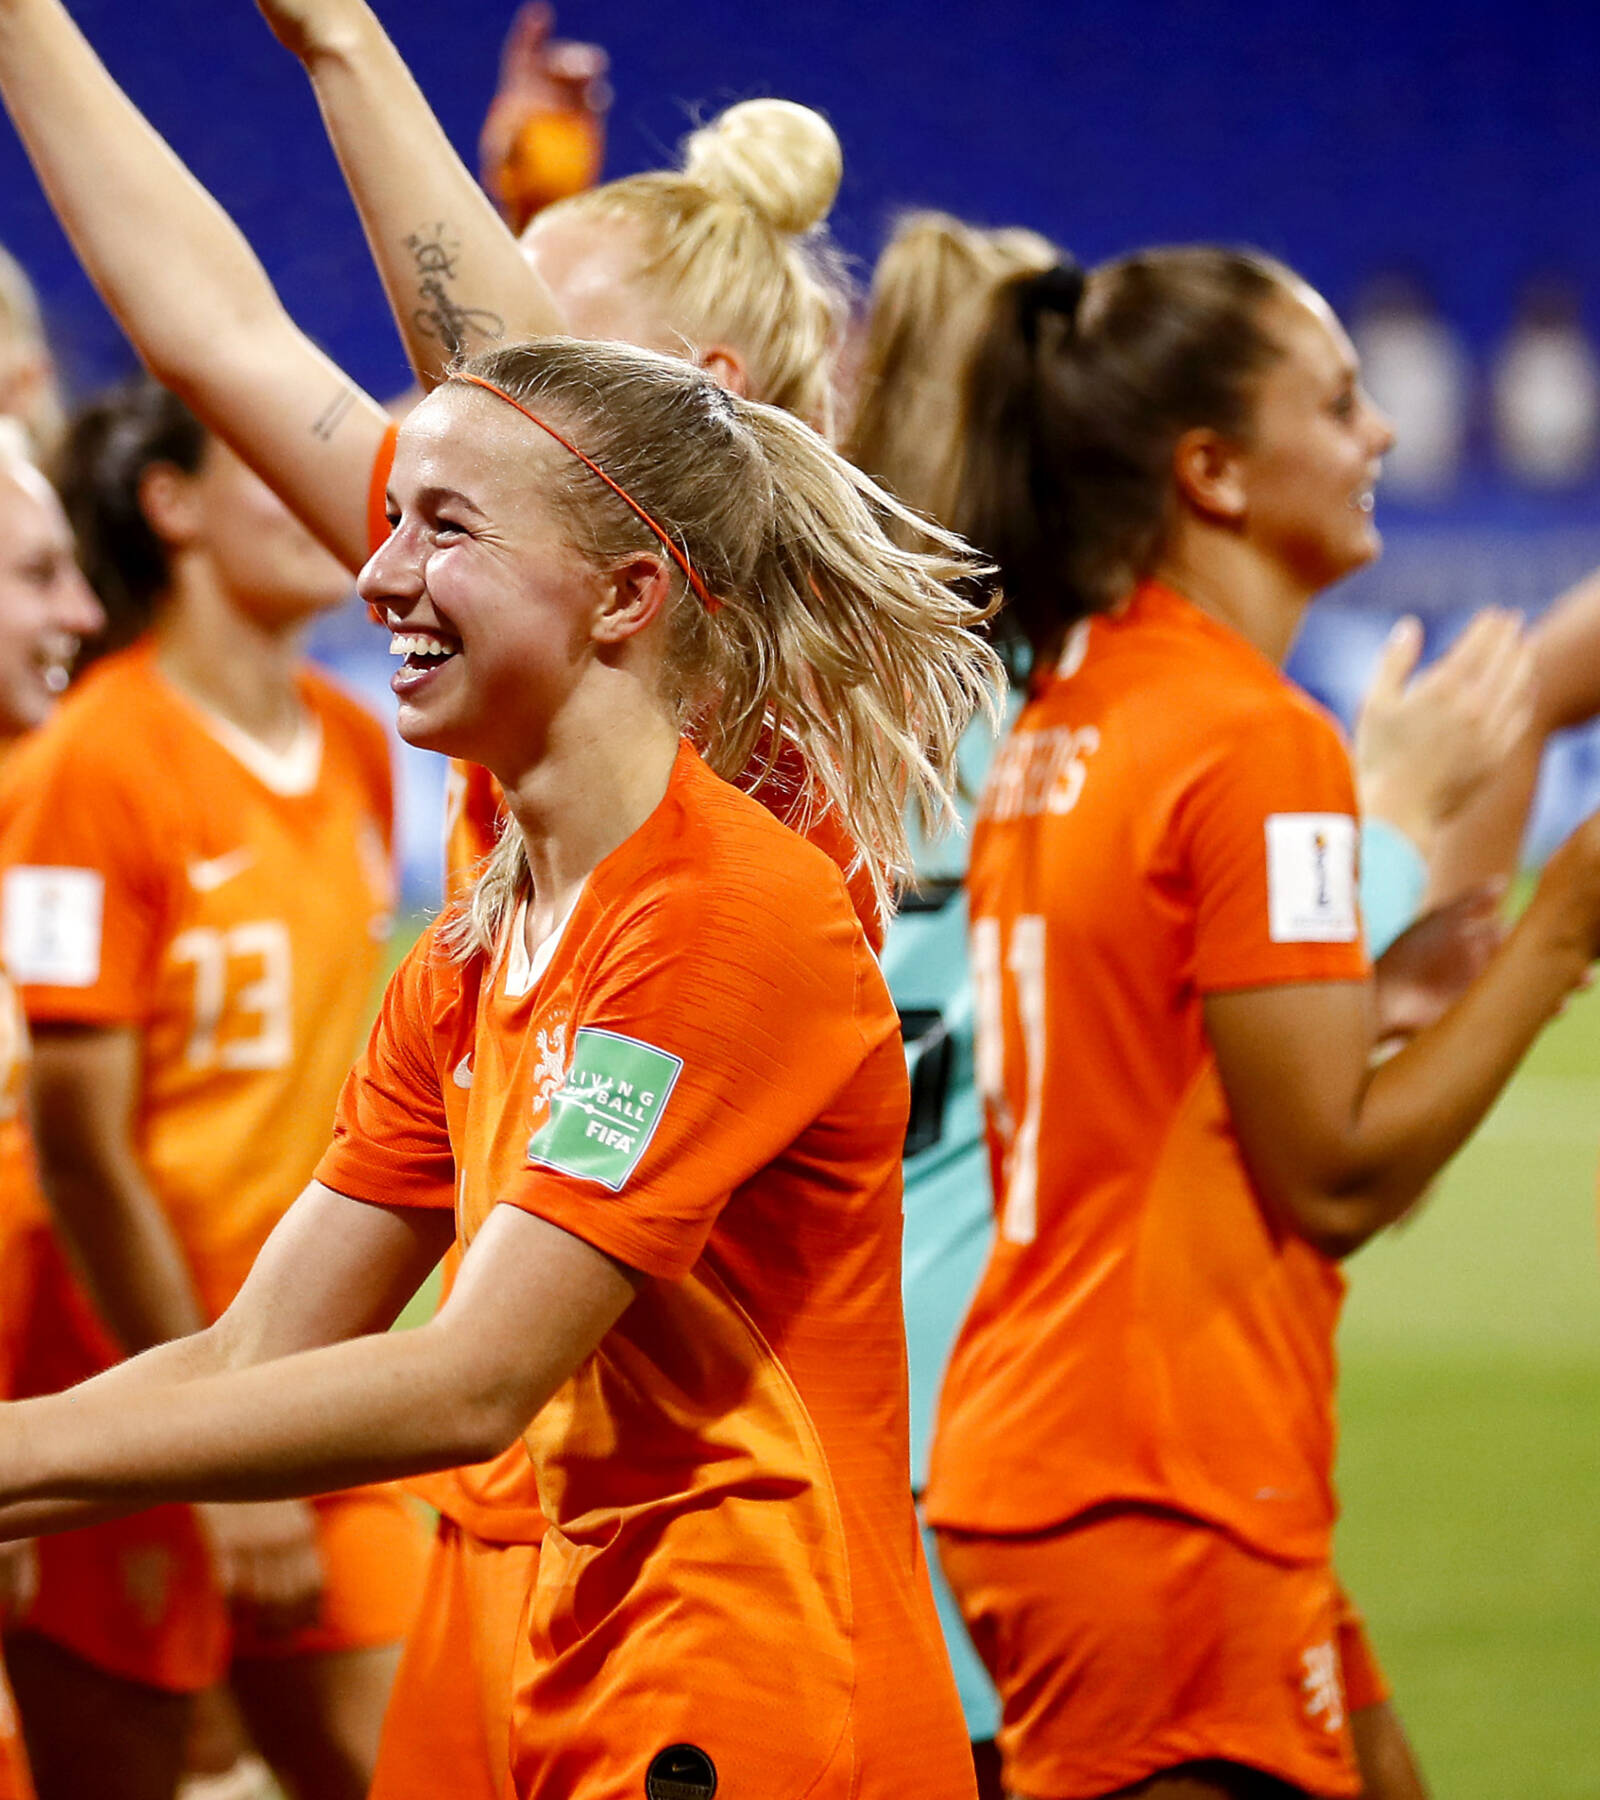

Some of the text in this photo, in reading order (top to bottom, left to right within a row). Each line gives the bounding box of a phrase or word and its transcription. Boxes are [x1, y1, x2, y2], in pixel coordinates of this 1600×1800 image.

[172, 919, 292, 1071] 13
[569, 1069, 655, 1107] LIVING
[586, 1119, 631, 1154] FIFA
